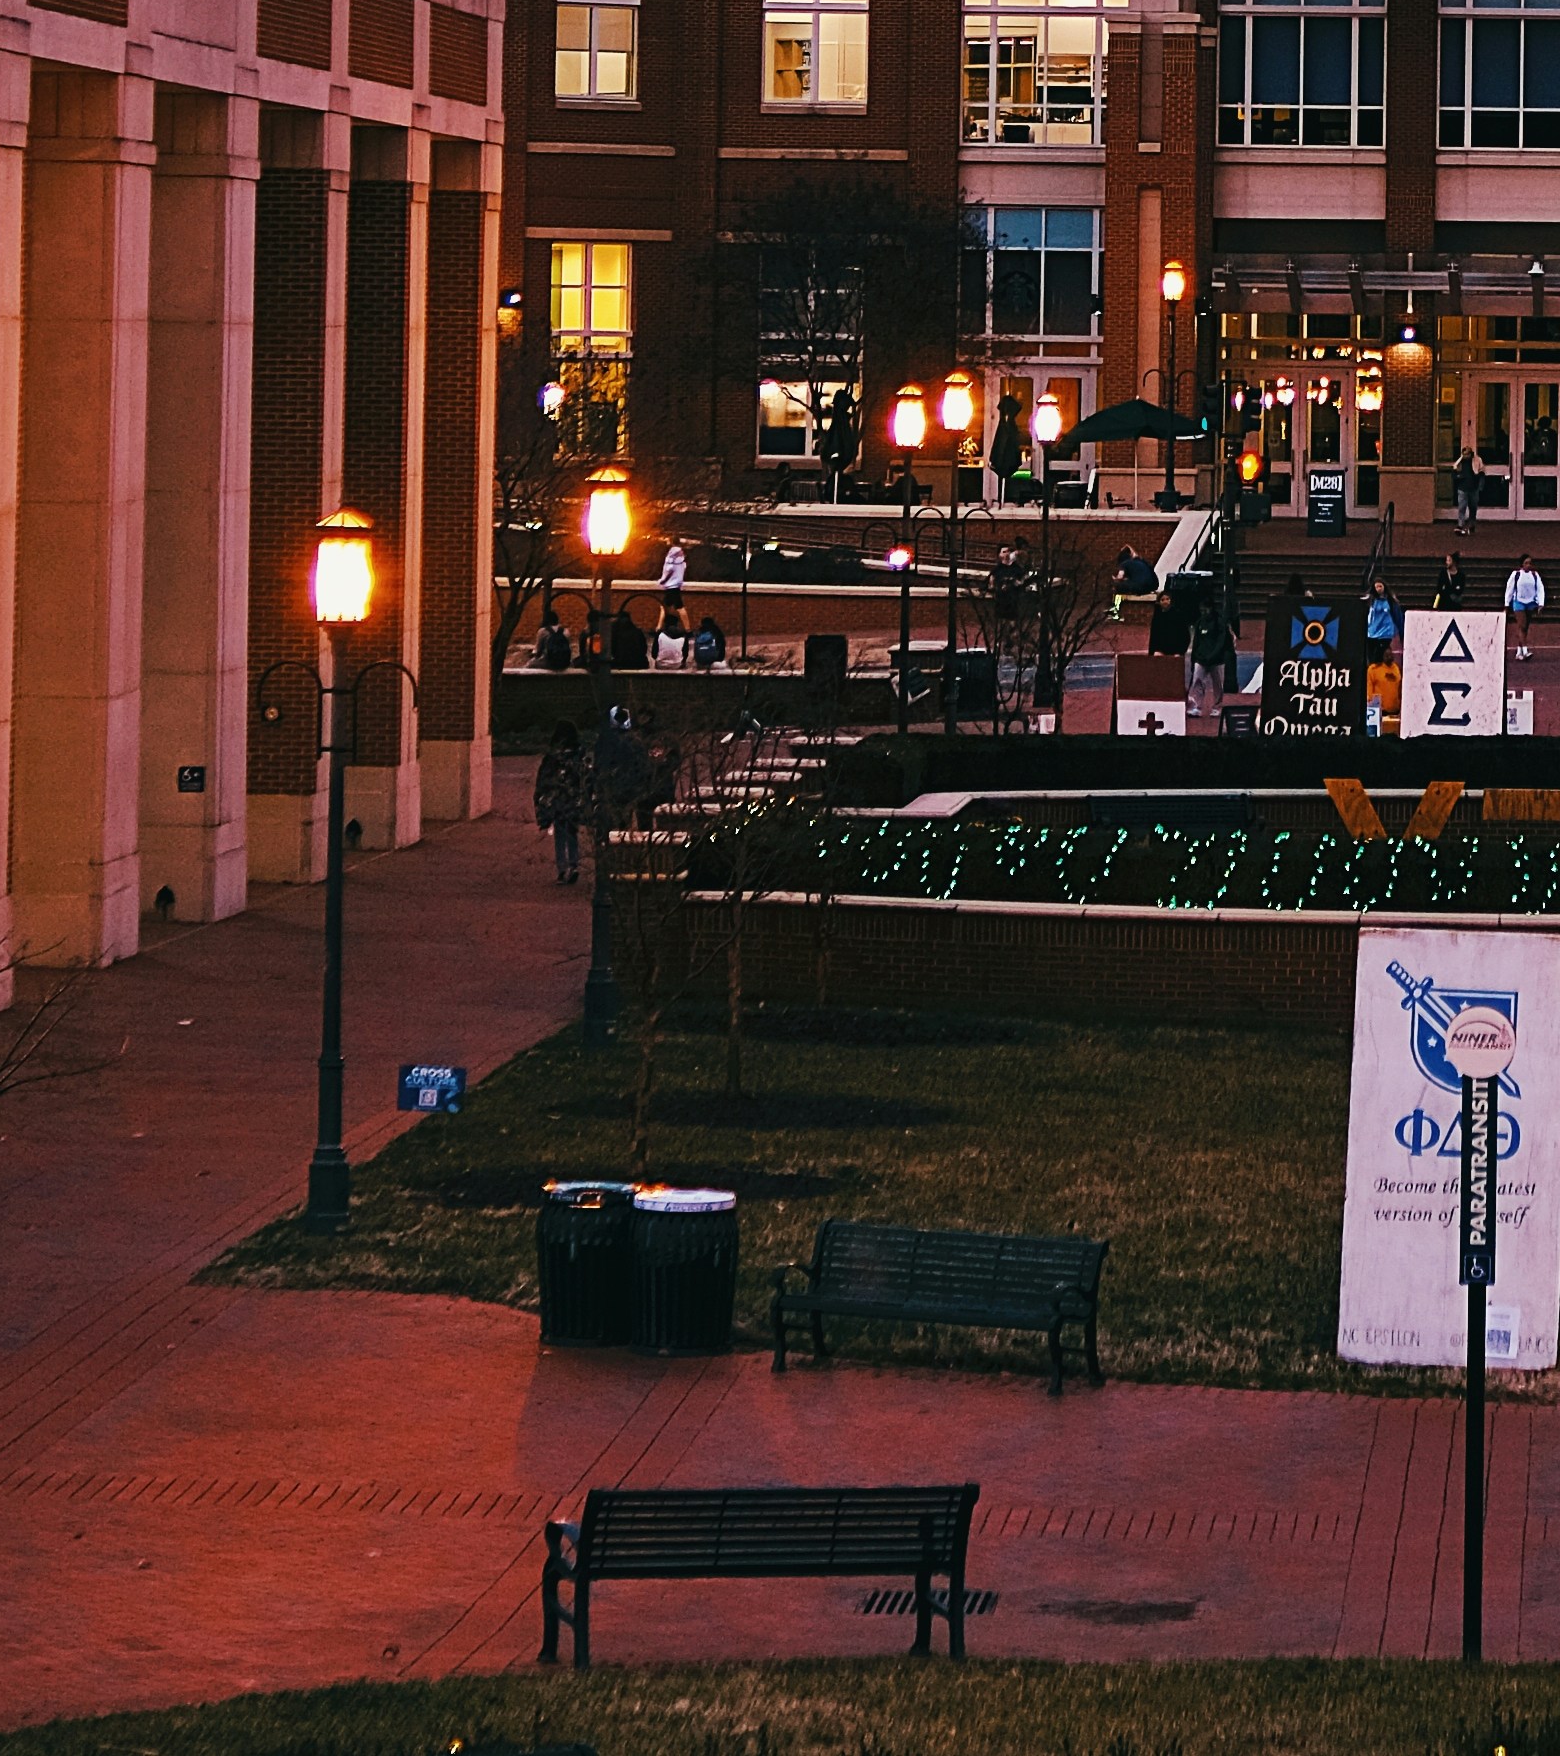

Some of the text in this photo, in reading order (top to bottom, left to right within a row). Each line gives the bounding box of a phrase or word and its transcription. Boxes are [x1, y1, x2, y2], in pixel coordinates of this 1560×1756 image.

[1279, 660, 1351, 692] Alpha
[1289, 693, 1338, 717] Tau
[411, 1066, 452, 1078] CROSS
[1469, 1078, 1489, 1246] PARATRANSIT
[1374, 1177, 1437, 1194] Become
[1442, 1177, 1460, 1194] th
[1374, 1206, 1433, 1223] version
[1438, 1206, 1456, 1229] of
[1342, 1328, 1359, 1345] NC
[1365, 1328, 1421, 1347] EPSILON
